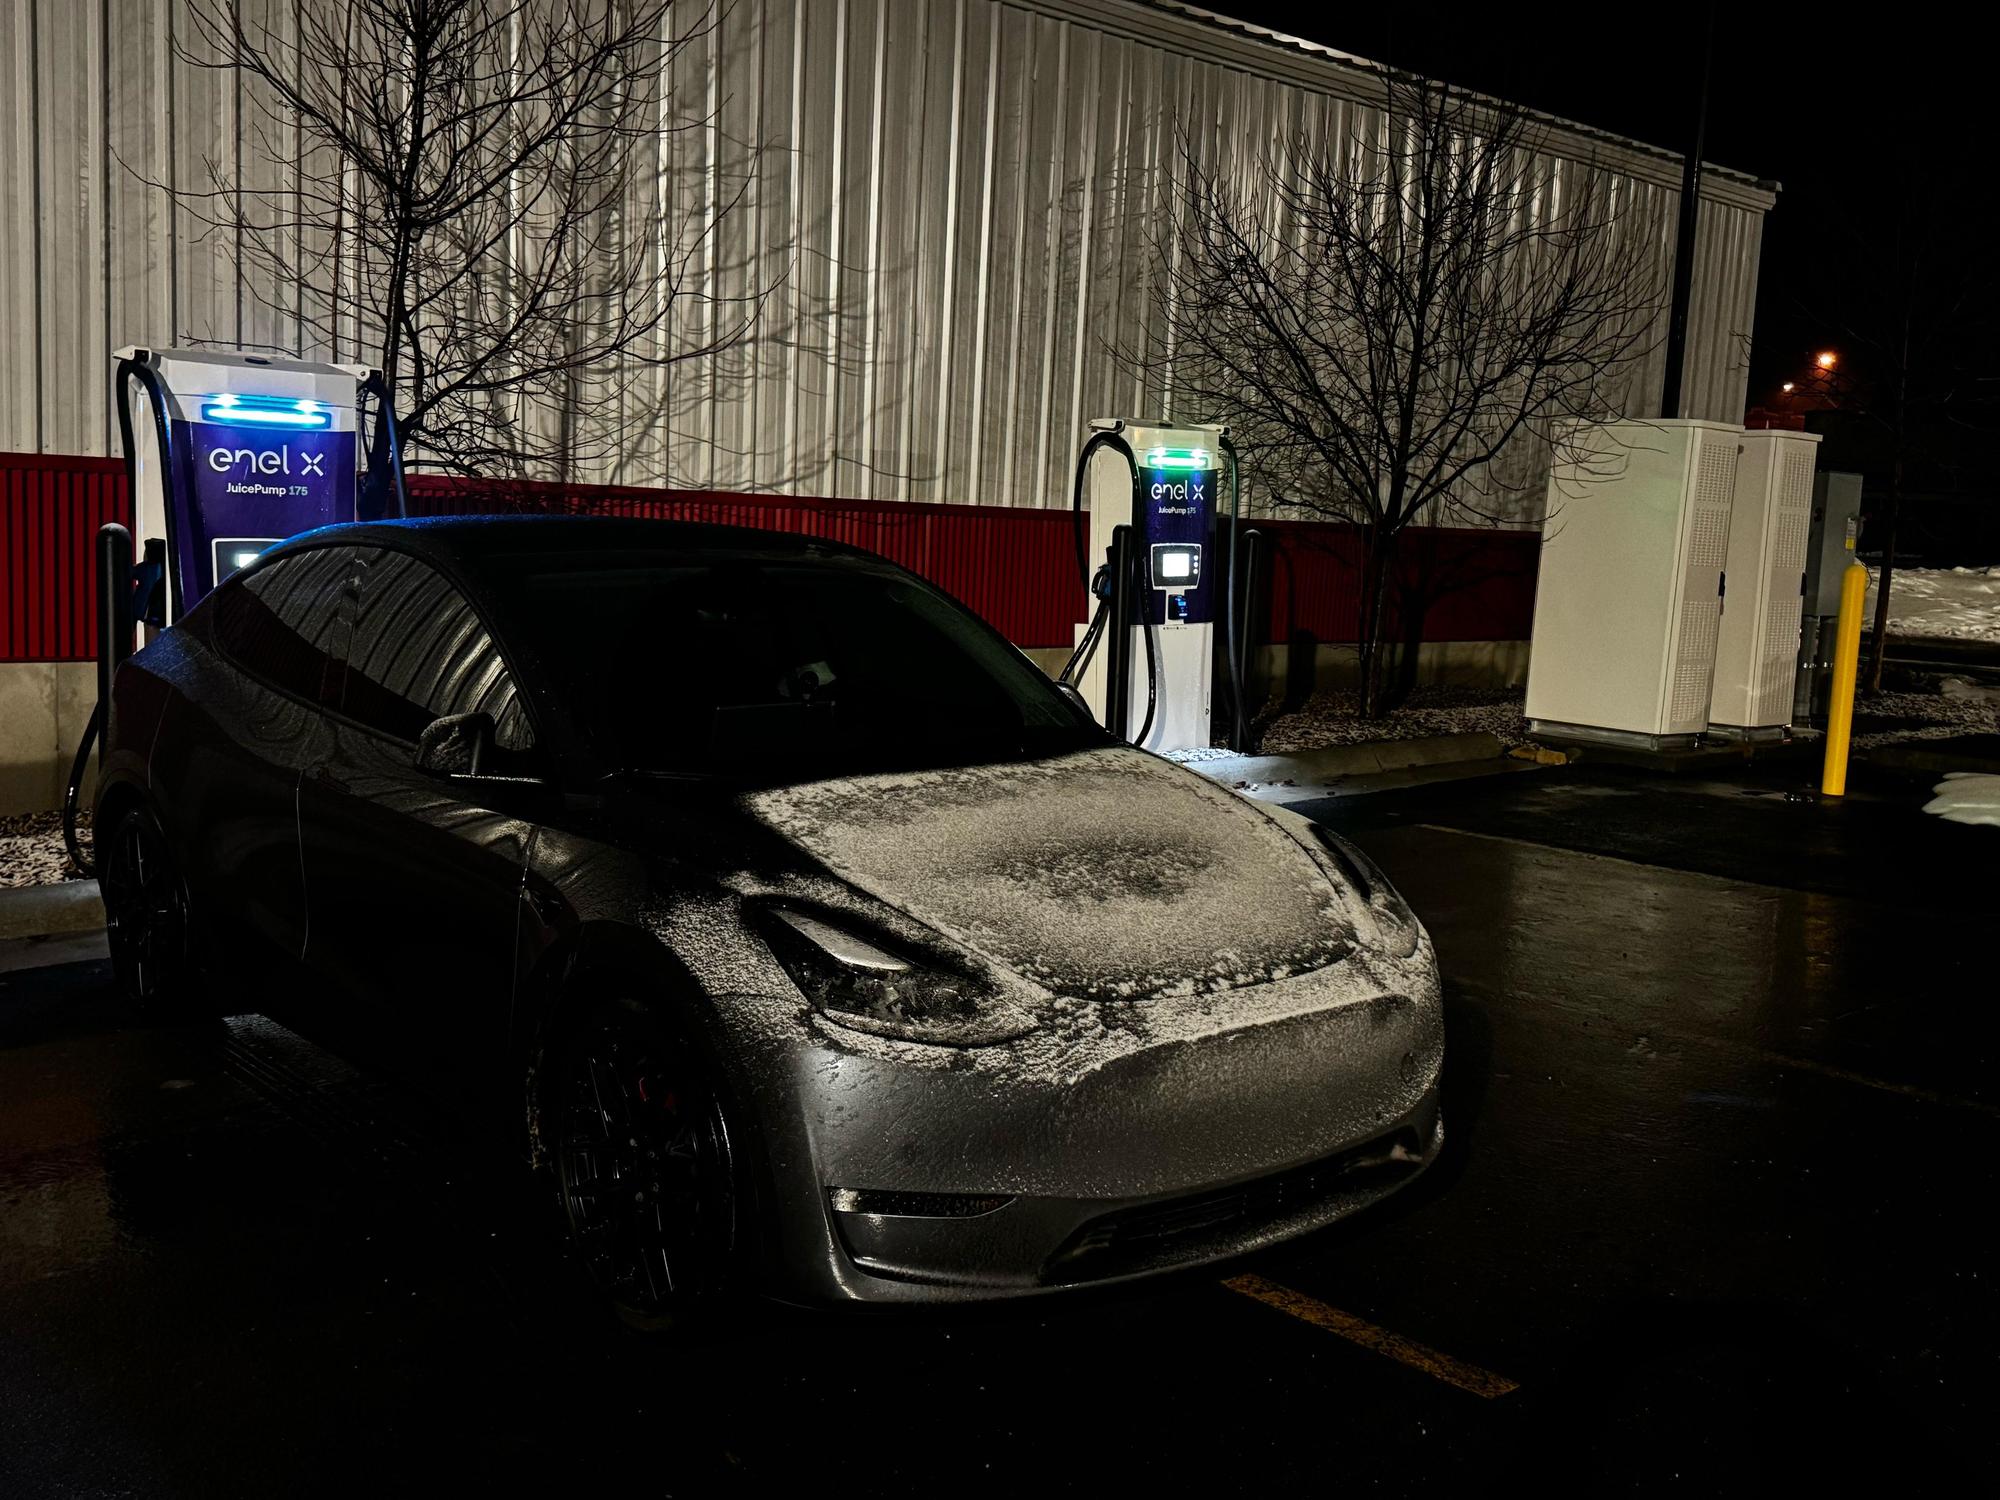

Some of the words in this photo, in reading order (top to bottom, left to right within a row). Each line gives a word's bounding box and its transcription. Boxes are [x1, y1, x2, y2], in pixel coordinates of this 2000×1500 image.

[209, 445, 290, 475] enel
[226, 482, 287, 497] JuicePump
[289, 486, 308, 496] 175
[1151, 480, 1188, 500] enel
